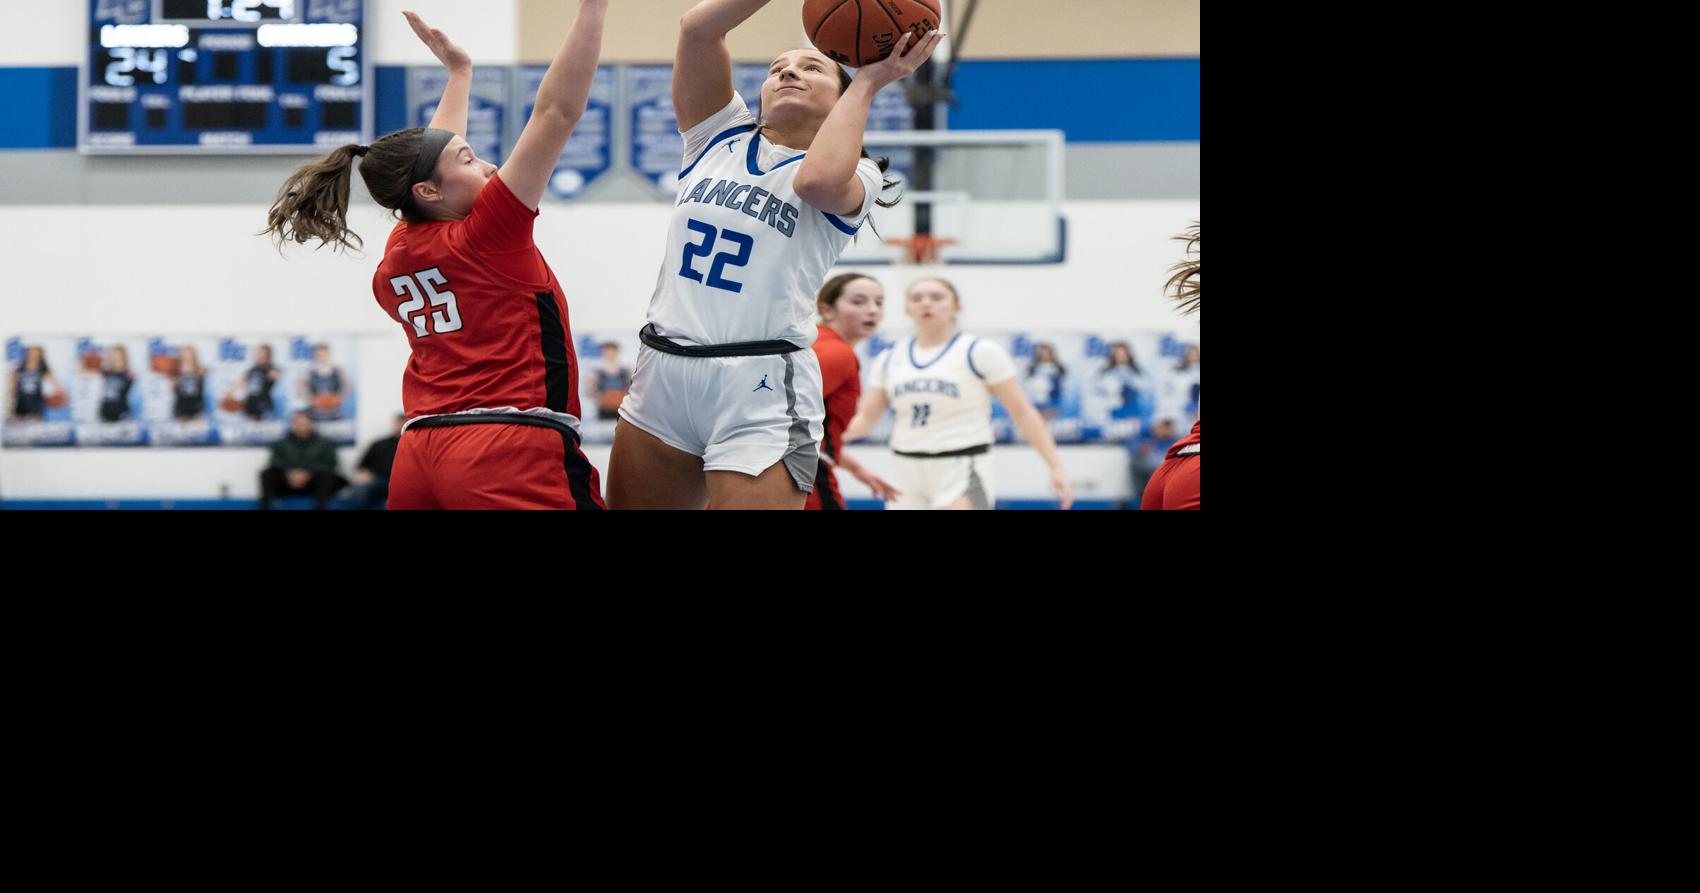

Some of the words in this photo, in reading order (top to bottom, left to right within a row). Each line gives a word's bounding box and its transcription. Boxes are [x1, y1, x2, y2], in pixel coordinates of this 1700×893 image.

[105, 48, 168, 86] 24
[327, 46, 360, 86] 5
[678, 218, 753, 293] 22
[389, 265, 463, 338] 25
